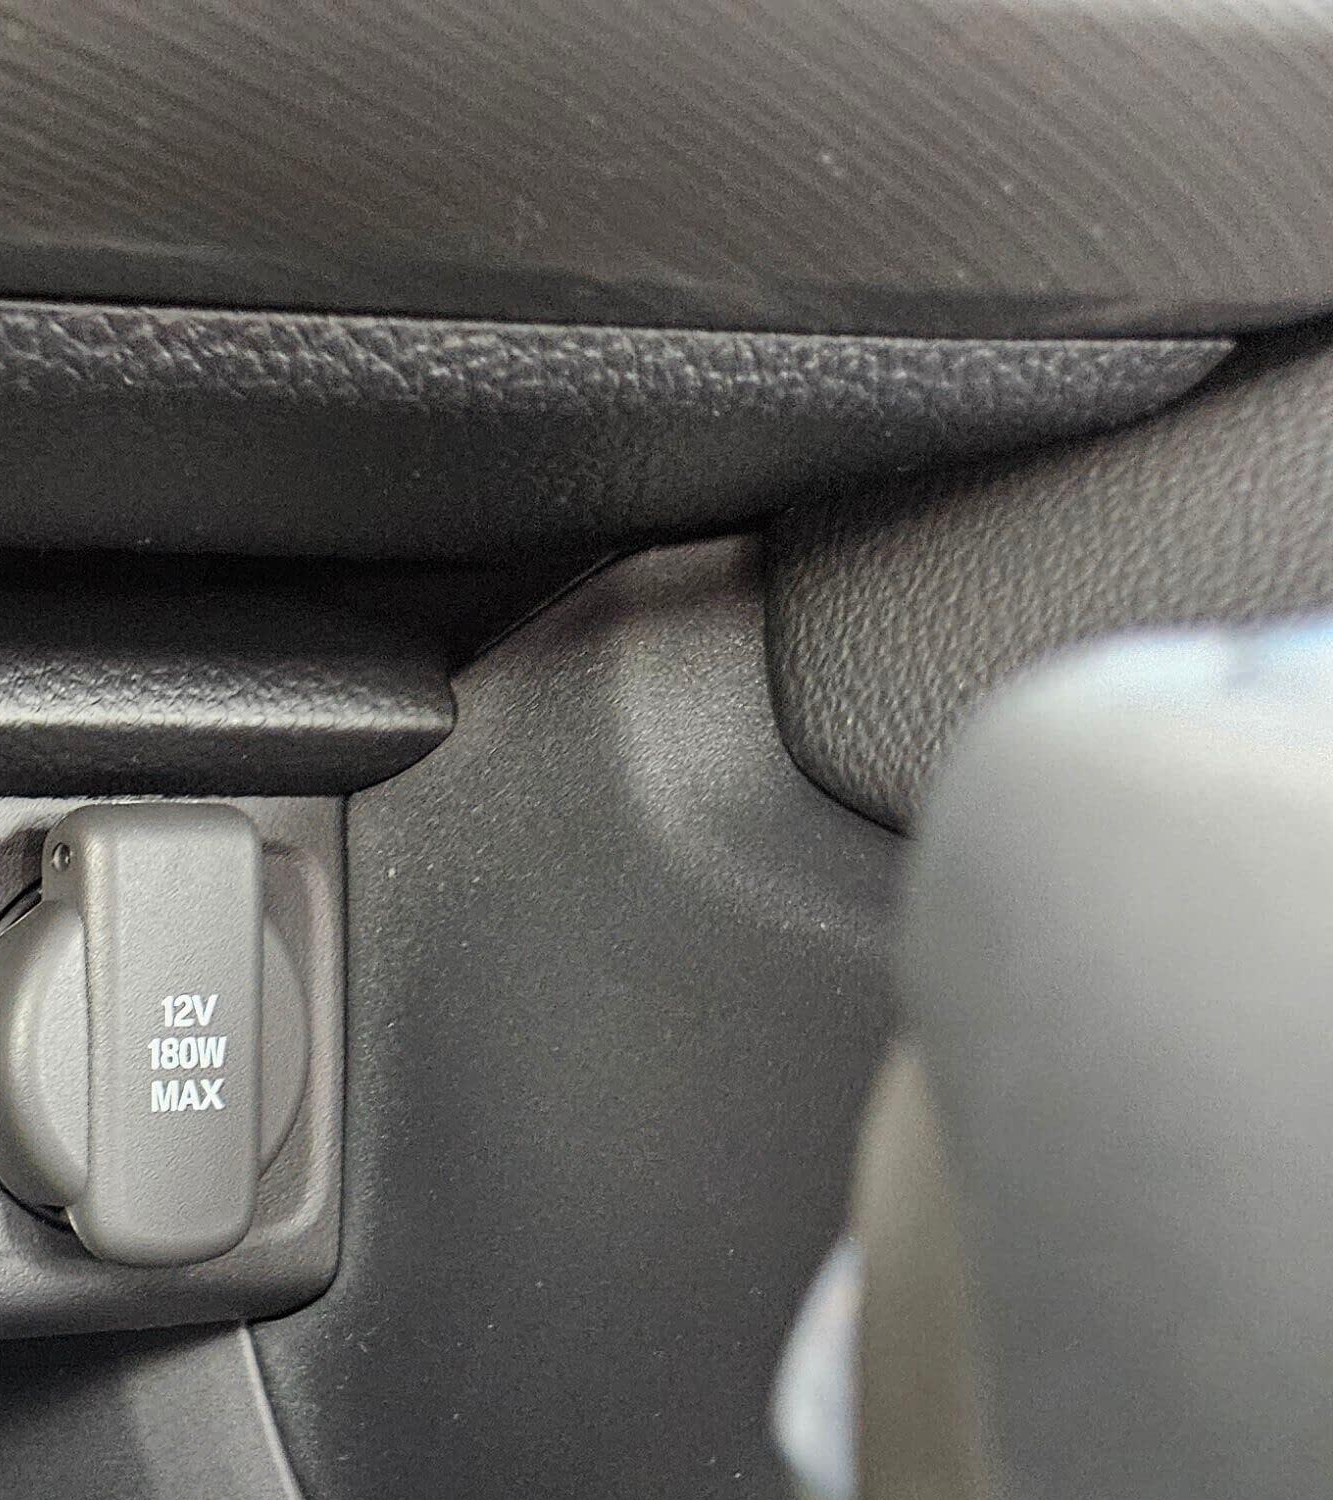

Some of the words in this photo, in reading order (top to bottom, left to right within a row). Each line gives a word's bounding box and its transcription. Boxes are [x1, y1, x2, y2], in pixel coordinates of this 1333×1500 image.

[161, 994, 219, 1028] 12V
[147, 1036, 227, 1071] 180W
[150, 1078, 225, 1113] MAX
